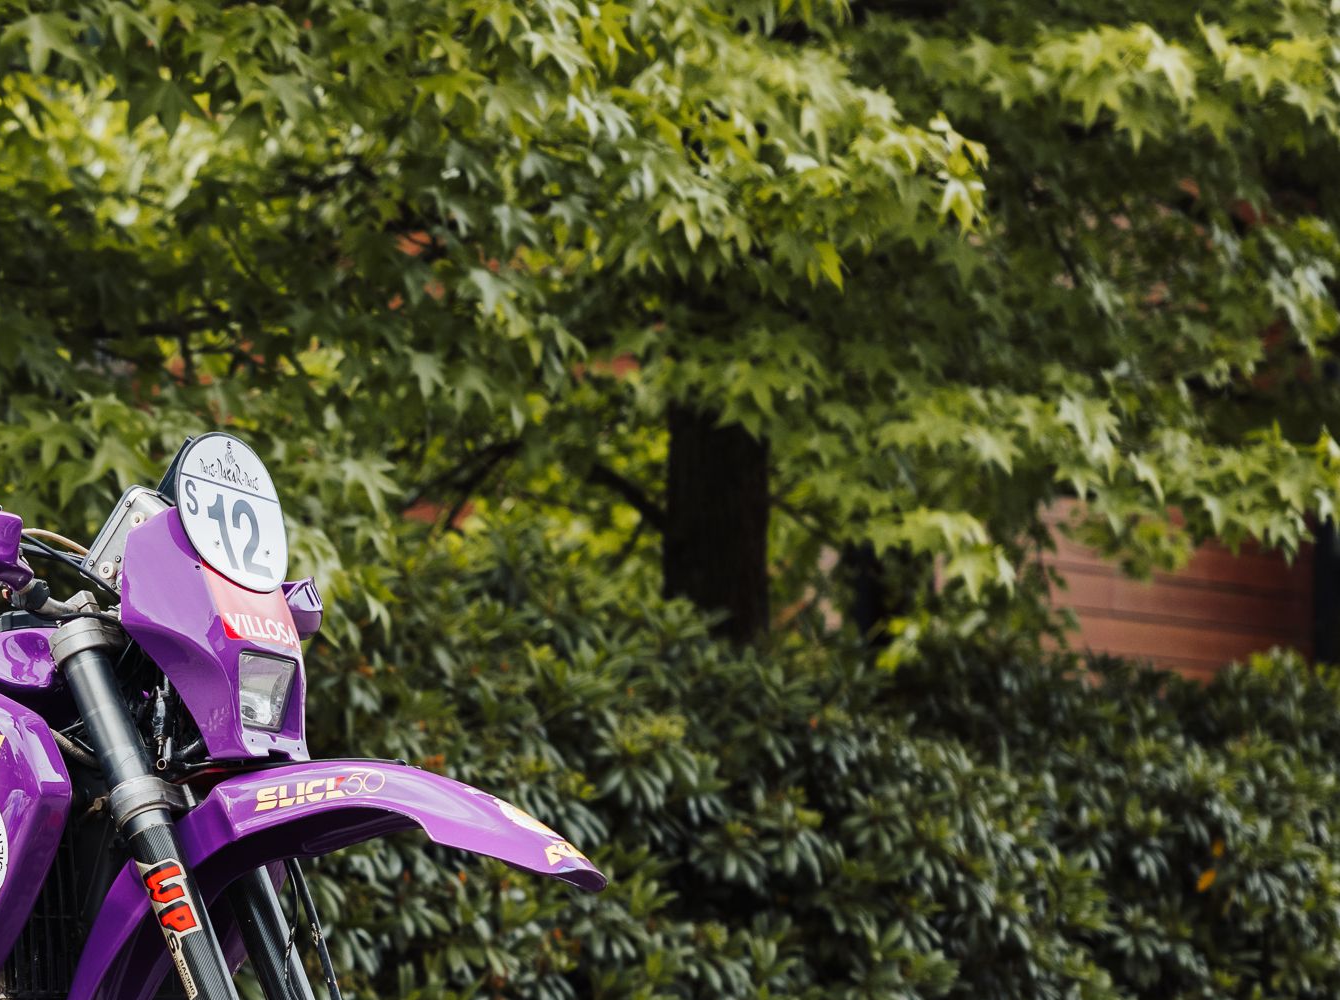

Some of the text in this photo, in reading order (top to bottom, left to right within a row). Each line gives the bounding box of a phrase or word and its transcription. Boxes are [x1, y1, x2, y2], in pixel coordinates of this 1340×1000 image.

[185, 479, 274, 580] S 12
[224, 612, 301, 650] VILLOSA
[254, 769, 386, 812] SLICK 50
[143, 860, 197, 933] WP
